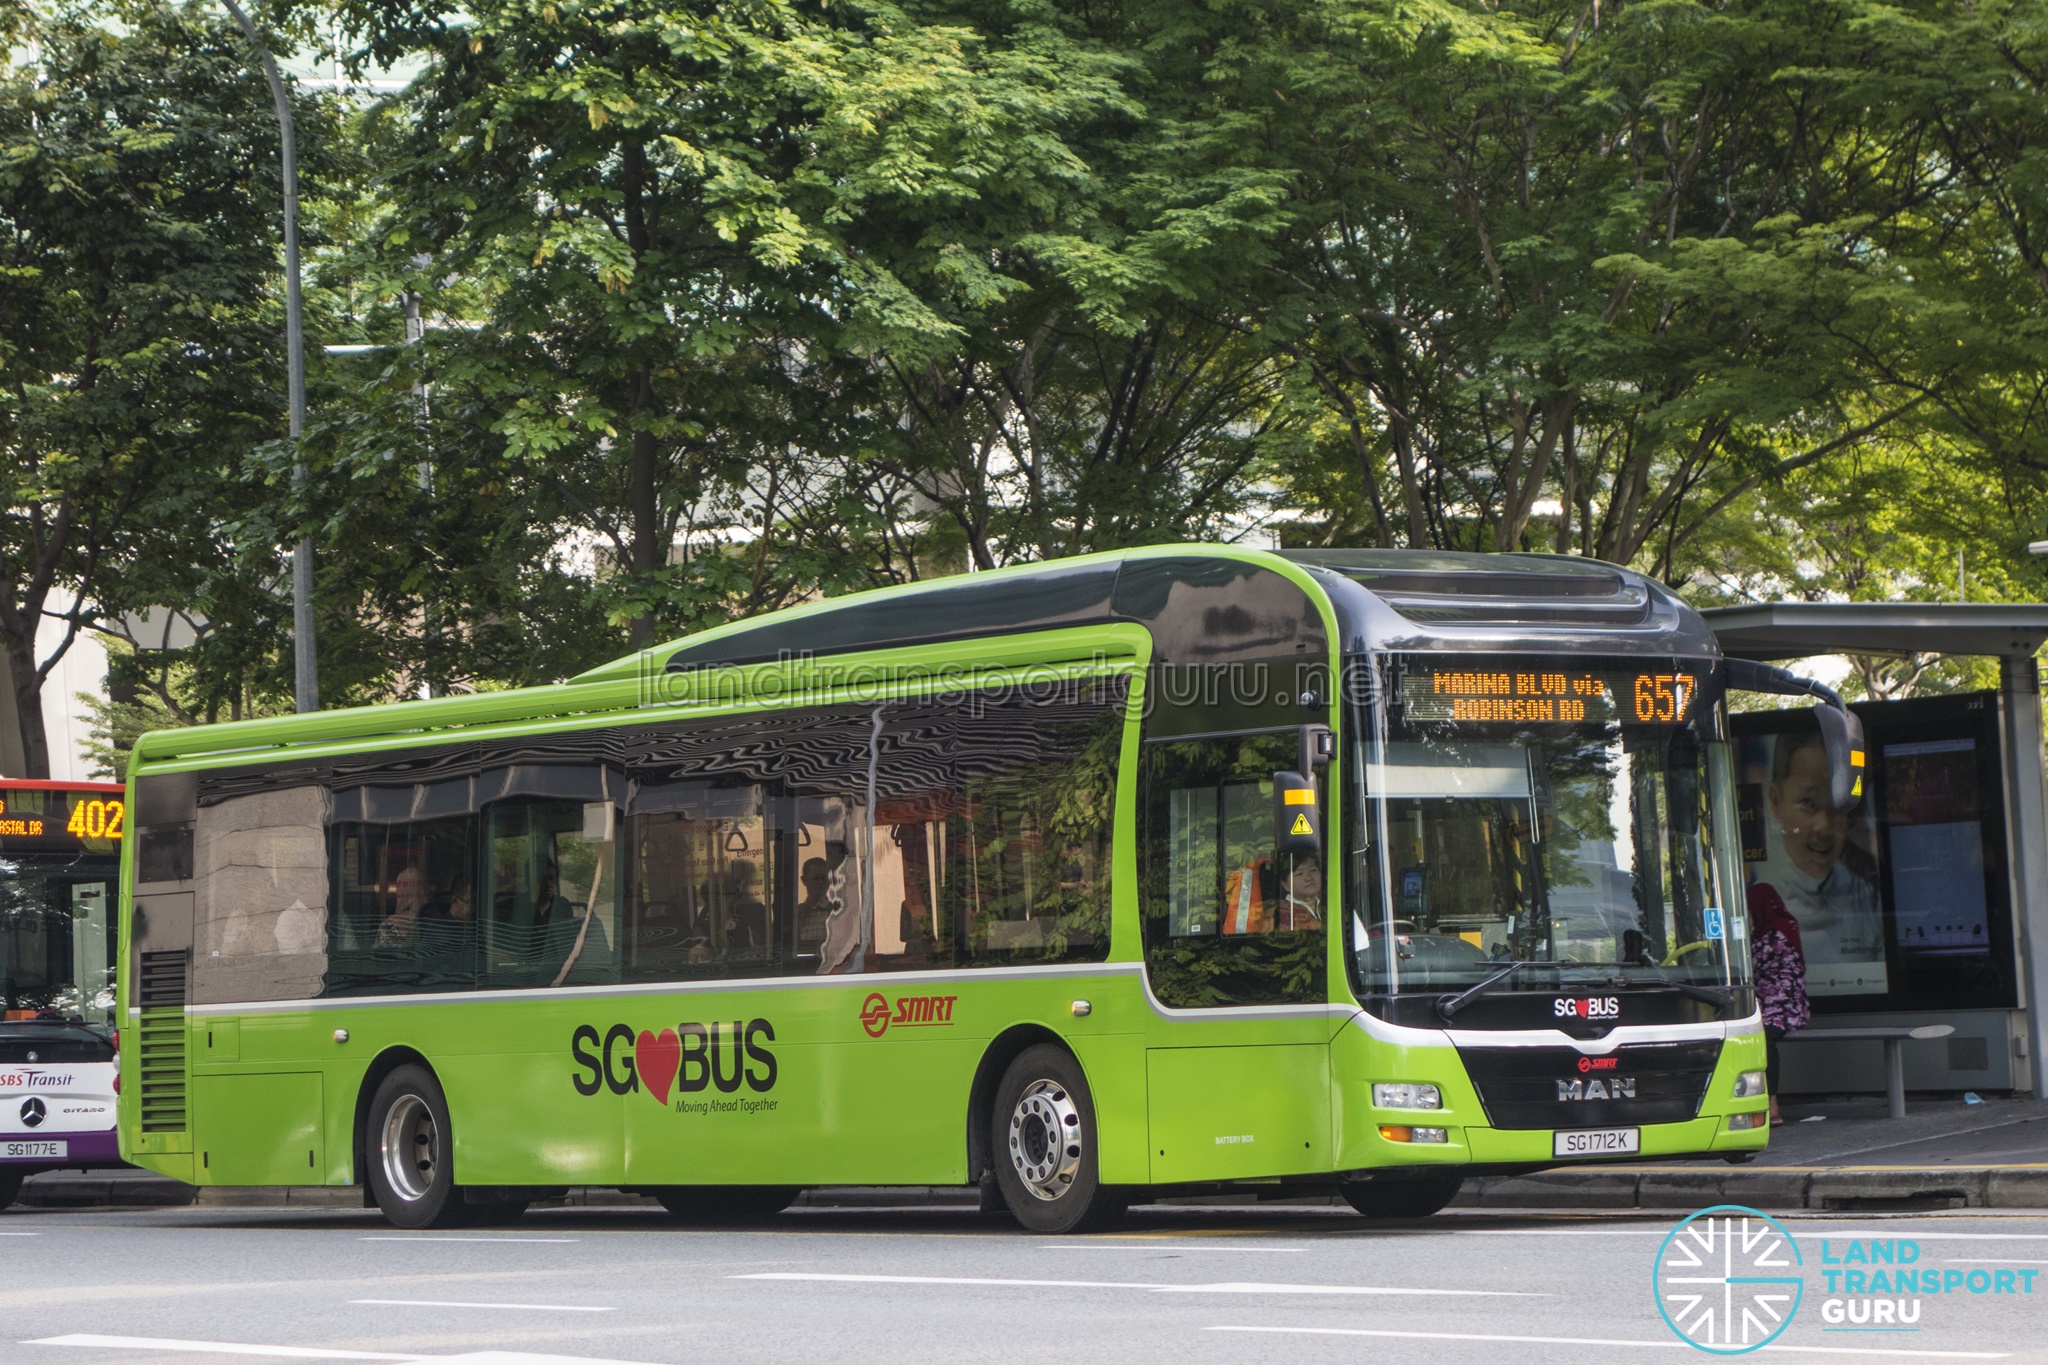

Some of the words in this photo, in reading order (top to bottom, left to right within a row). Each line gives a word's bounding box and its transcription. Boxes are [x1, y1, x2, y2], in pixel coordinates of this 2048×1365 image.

[1434, 673, 1510, 695] MARINA
[1516, 674, 1567, 695] BLVD
[1573, 674, 1604, 695] via
[1635, 675, 1694, 721] 657
[1454, 699, 1553, 721] ROBINSON
[1559, 699, 1585, 721] RD
[29, 820, 43, 835] DR
[67, 800, 124, 838] 402
[891, 996, 958, 1023] SMRT
[1592, 1058, 1618, 1068] SMRT
[0, 1074, 23, 1086] SBS
[22, 1070, 76, 1088] Transit
[1555, 1077, 1636, 1102] MAN
[675, 1100, 708, 1116] Moving
[709, 1098, 738, 1113] Ahead
[739, 1097, 779, 1115] Together
[7, 1143, 57, 1156] SG1177E
[1216, 1136, 1240, 1144] BATTERY
[1567, 1132, 1628, 1151] SG1712K
